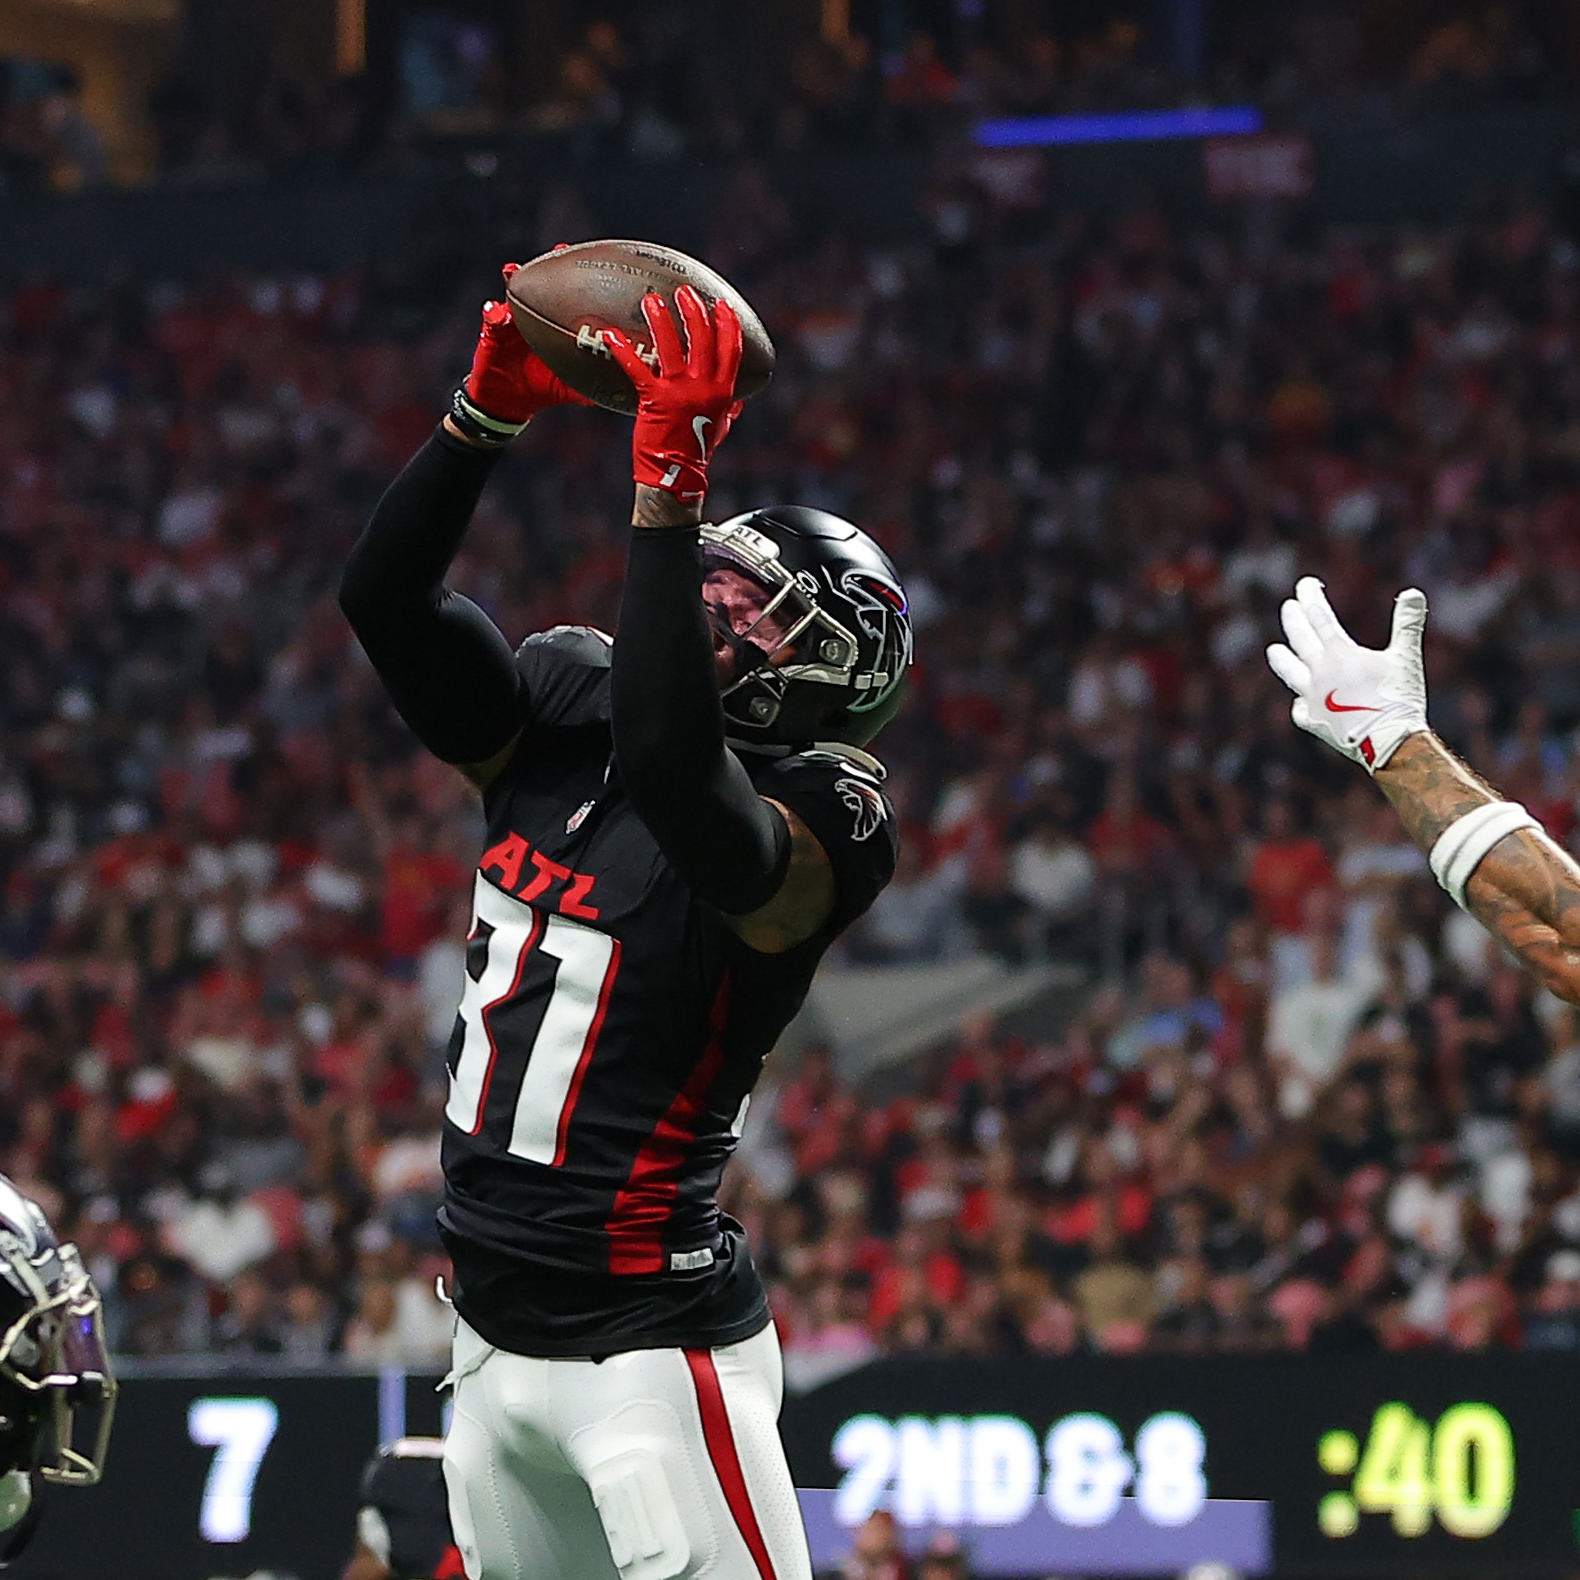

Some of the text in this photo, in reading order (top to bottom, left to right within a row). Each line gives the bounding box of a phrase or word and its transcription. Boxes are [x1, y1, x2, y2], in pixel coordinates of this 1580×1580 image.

[734, 526, 764, 546] ATL
[478, 830, 599, 920] ATL
[187, 1397, 279, 1543] 7
[831, 1412, 1041, 1528] 2ND
[1135, 1411, 1208, 1527] 8
[1317, 1401, 1517, 1541] :40
